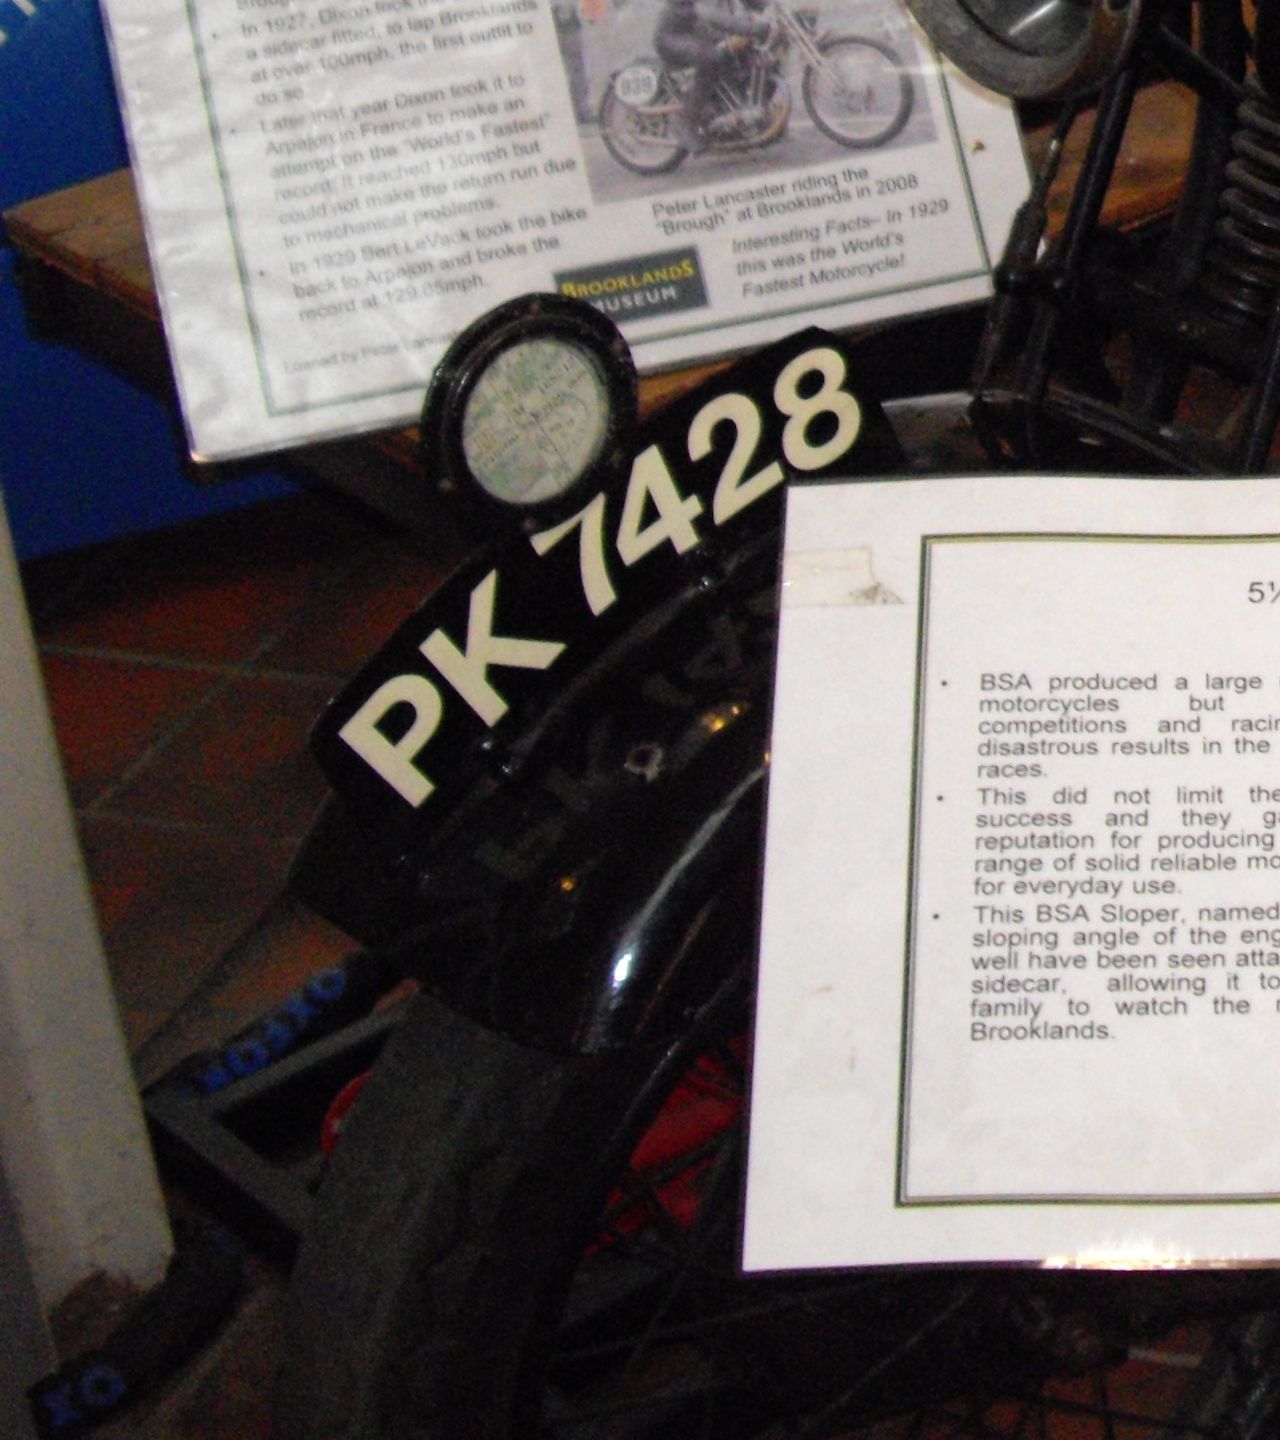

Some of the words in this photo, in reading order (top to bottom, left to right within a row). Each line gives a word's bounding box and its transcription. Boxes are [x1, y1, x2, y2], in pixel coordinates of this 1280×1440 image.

[653, 199, 700, 220] Peter
[702, 183, 787, 209] Lancaster
[791, 173, 840, 194] riding
[841, 167, 870, 183] the
[735, 206, 755, 222] at
[756, 188, 853, 218] Brooklands
[854, 184, 873, 200] in
[875, 174, 920, 196] 2008
[731, 225, 823, 255] Interesting
[884, 208, 904, 225] In
[908, 199, 952, 220] 1929
[734, 258, 770, 276] this
[770, 253, 808, 269] was
[809, 245, 838, 262] the
[741, 273, 806, 298] Fastest
[339, 568, 566, 809] PK
[532, 347, 863, 617] 7428
[979, 673, 1033, 692] BSA
[1048, 672, 1159, 695] produced
[1174, 676, 1189, 690] a
[1205, 672, 1264, 694] large
[978, 694, 1120, 717] motorcycles
[1188, 691, 1225, 711] but
[978, 715, 1128, 740] competitions
[1157, 715, 1202, 733] and
[977, 738, 1100, 757] disastrous
[1110, 737, 1191, 755] results
[1201, 736, 1223, 754] in
[1233, 735, 1272, 754] the
[977, 763, 1048, 778] races.
[972, 904, 1026, 924] This
[1035, 903, 1091, 924] BSA
[1100, 903, 1186, 927] Sloper,
[1197, 901, 1280, 921] named
[972, 927, 1060, 952] sloping
[1072, 927, 1141, 951] angle
[1152, 925, 1178, 945] of
[1188, 925, 1228, 944] the
[970, 950, 1020, 971] well
[1027, 950, 1089, 970] have
[1096, 948, 1159, 969] been
[1167, 952, 1227, 968] seen
